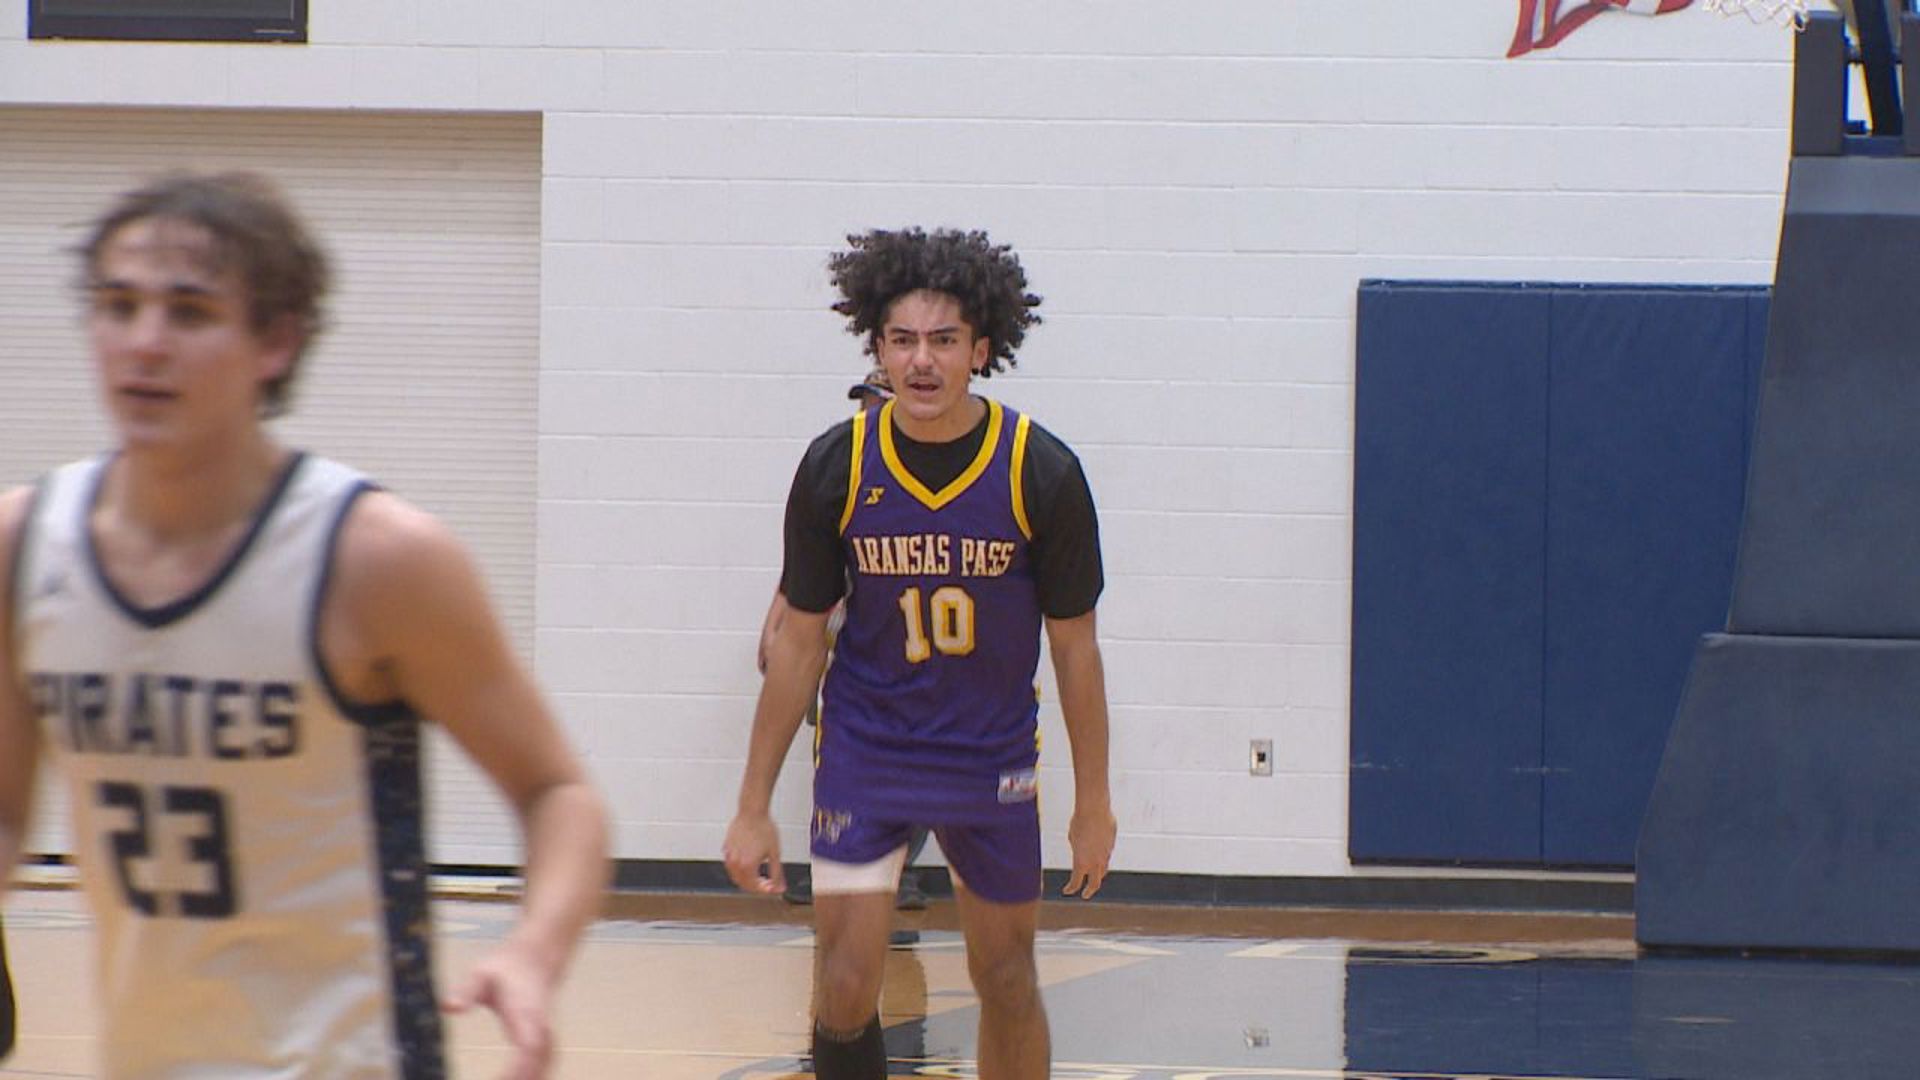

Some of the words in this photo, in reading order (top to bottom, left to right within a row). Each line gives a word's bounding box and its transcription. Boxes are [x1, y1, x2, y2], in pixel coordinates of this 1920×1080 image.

[852, 534, 951, 576] ARANSAS
[960, 537, 1016, 578] PASS
[898, 586, 976, 665] 10
[27, 672, 304, 760] PIRATES
[93, 781, 241, 919] 23
